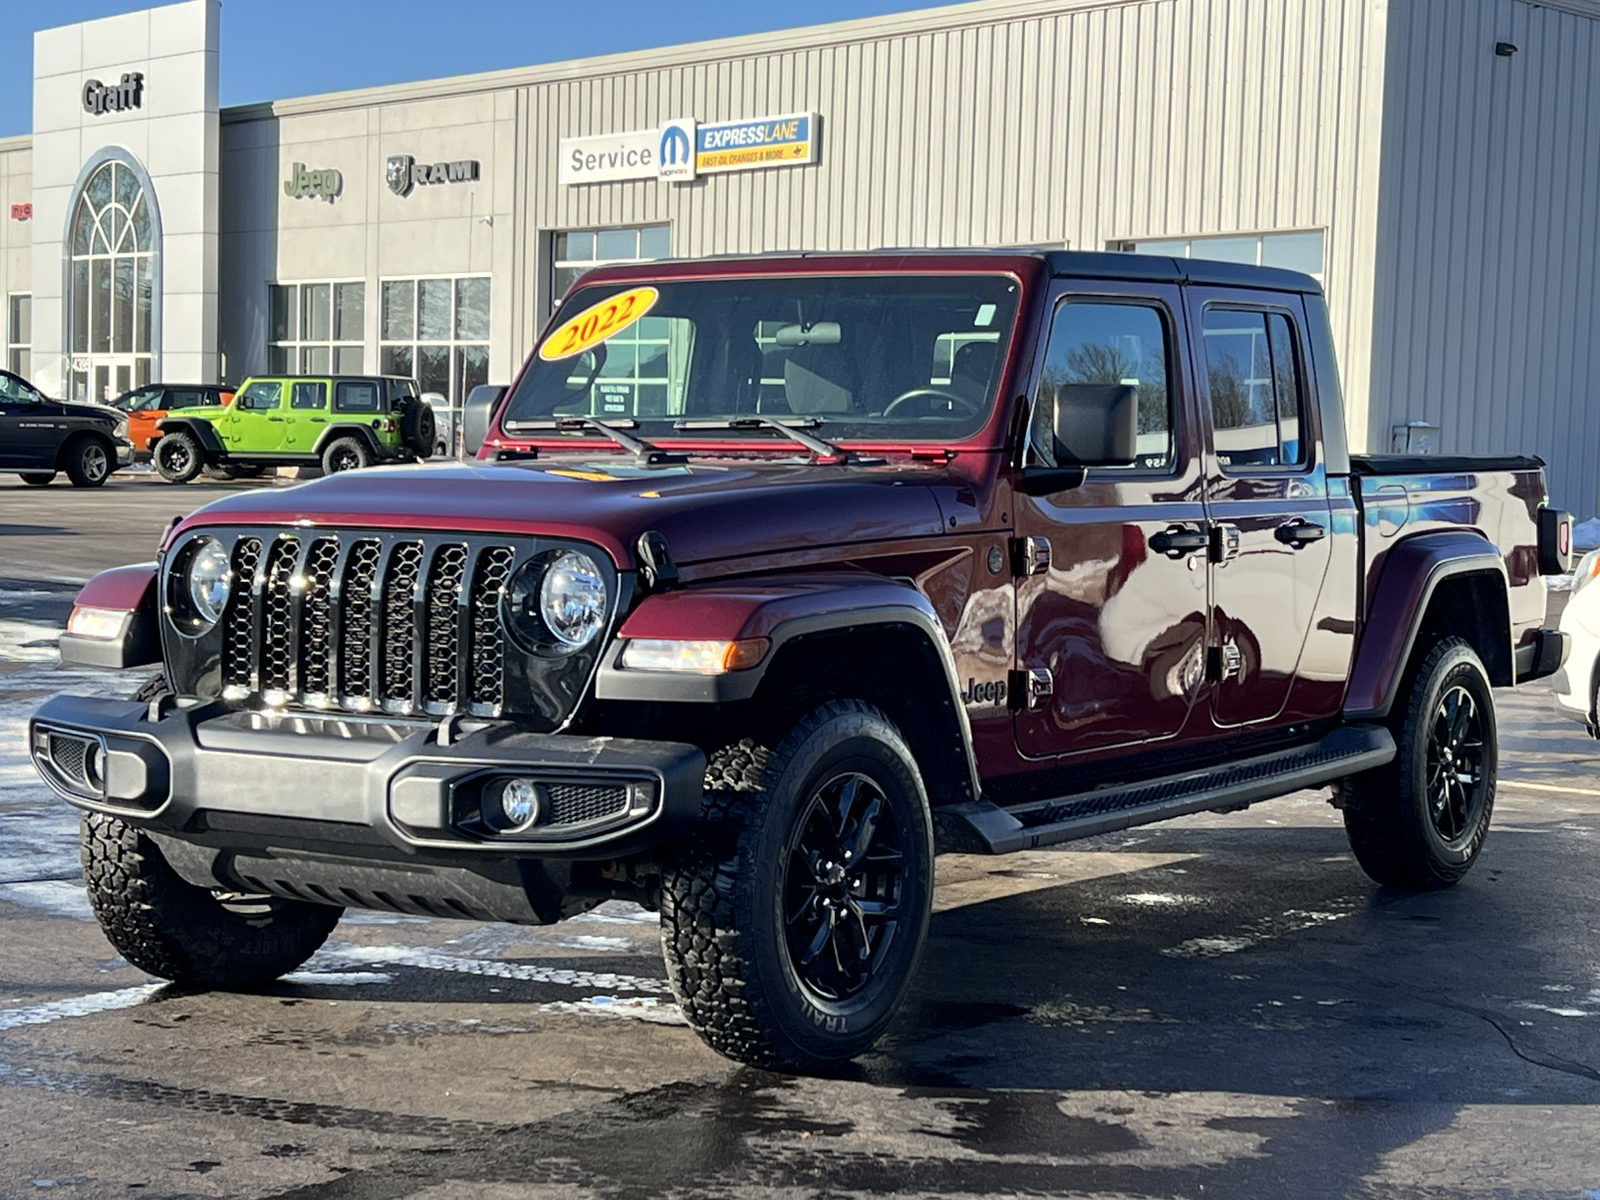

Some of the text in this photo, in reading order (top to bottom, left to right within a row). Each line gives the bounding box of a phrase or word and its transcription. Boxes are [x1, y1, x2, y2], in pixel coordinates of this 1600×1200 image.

[82, 72, 144, 115] Graff
[411, 160, 480, 185] RAM
[571, 144, 652, 172] Service
[702, 156, 718, 167] FAST
[728, 151, 758, 164] CHANGES
[765, 149, 784, 161] MORE
[284, 162, 343, 204] Jeep
[560, 296, 636, 354] 2022
[960, 677, 1006, 706] Jeep
[801, 995, 848, 1033] TRAIL
